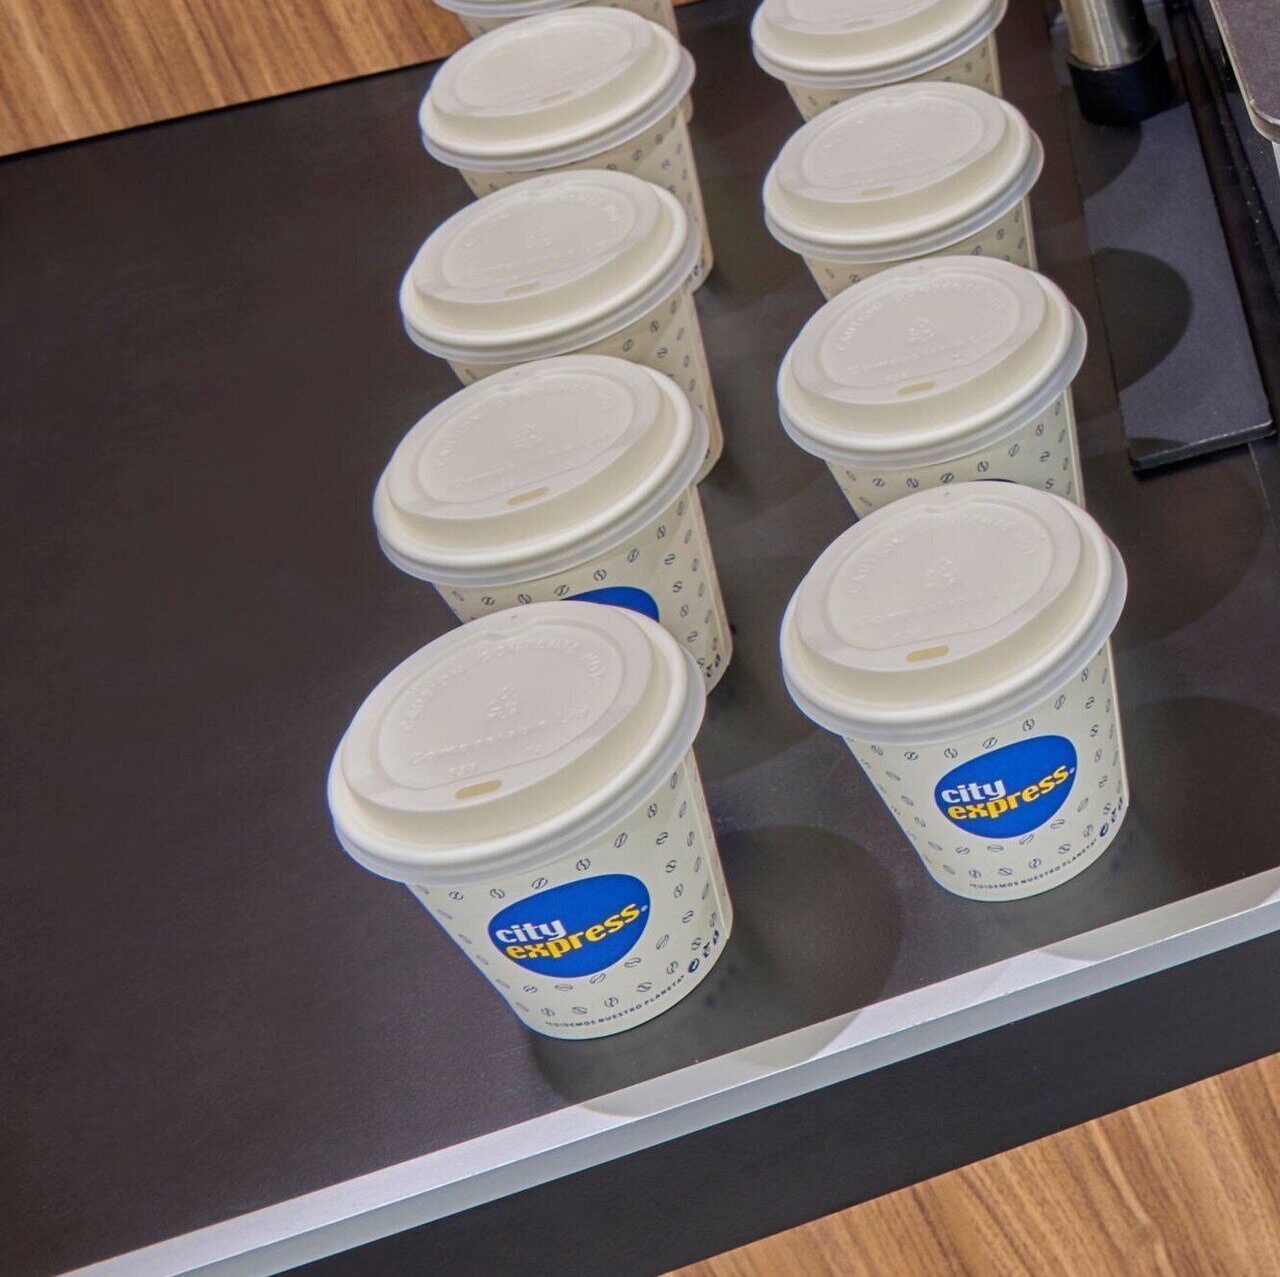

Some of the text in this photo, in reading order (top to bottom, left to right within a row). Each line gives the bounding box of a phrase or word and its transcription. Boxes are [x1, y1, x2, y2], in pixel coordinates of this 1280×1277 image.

[941, 779, 1007, 803] city
[947, 765, 1069, 820] express
[495, 919, 567, 944] city
[506, 903, 641, 959] express
